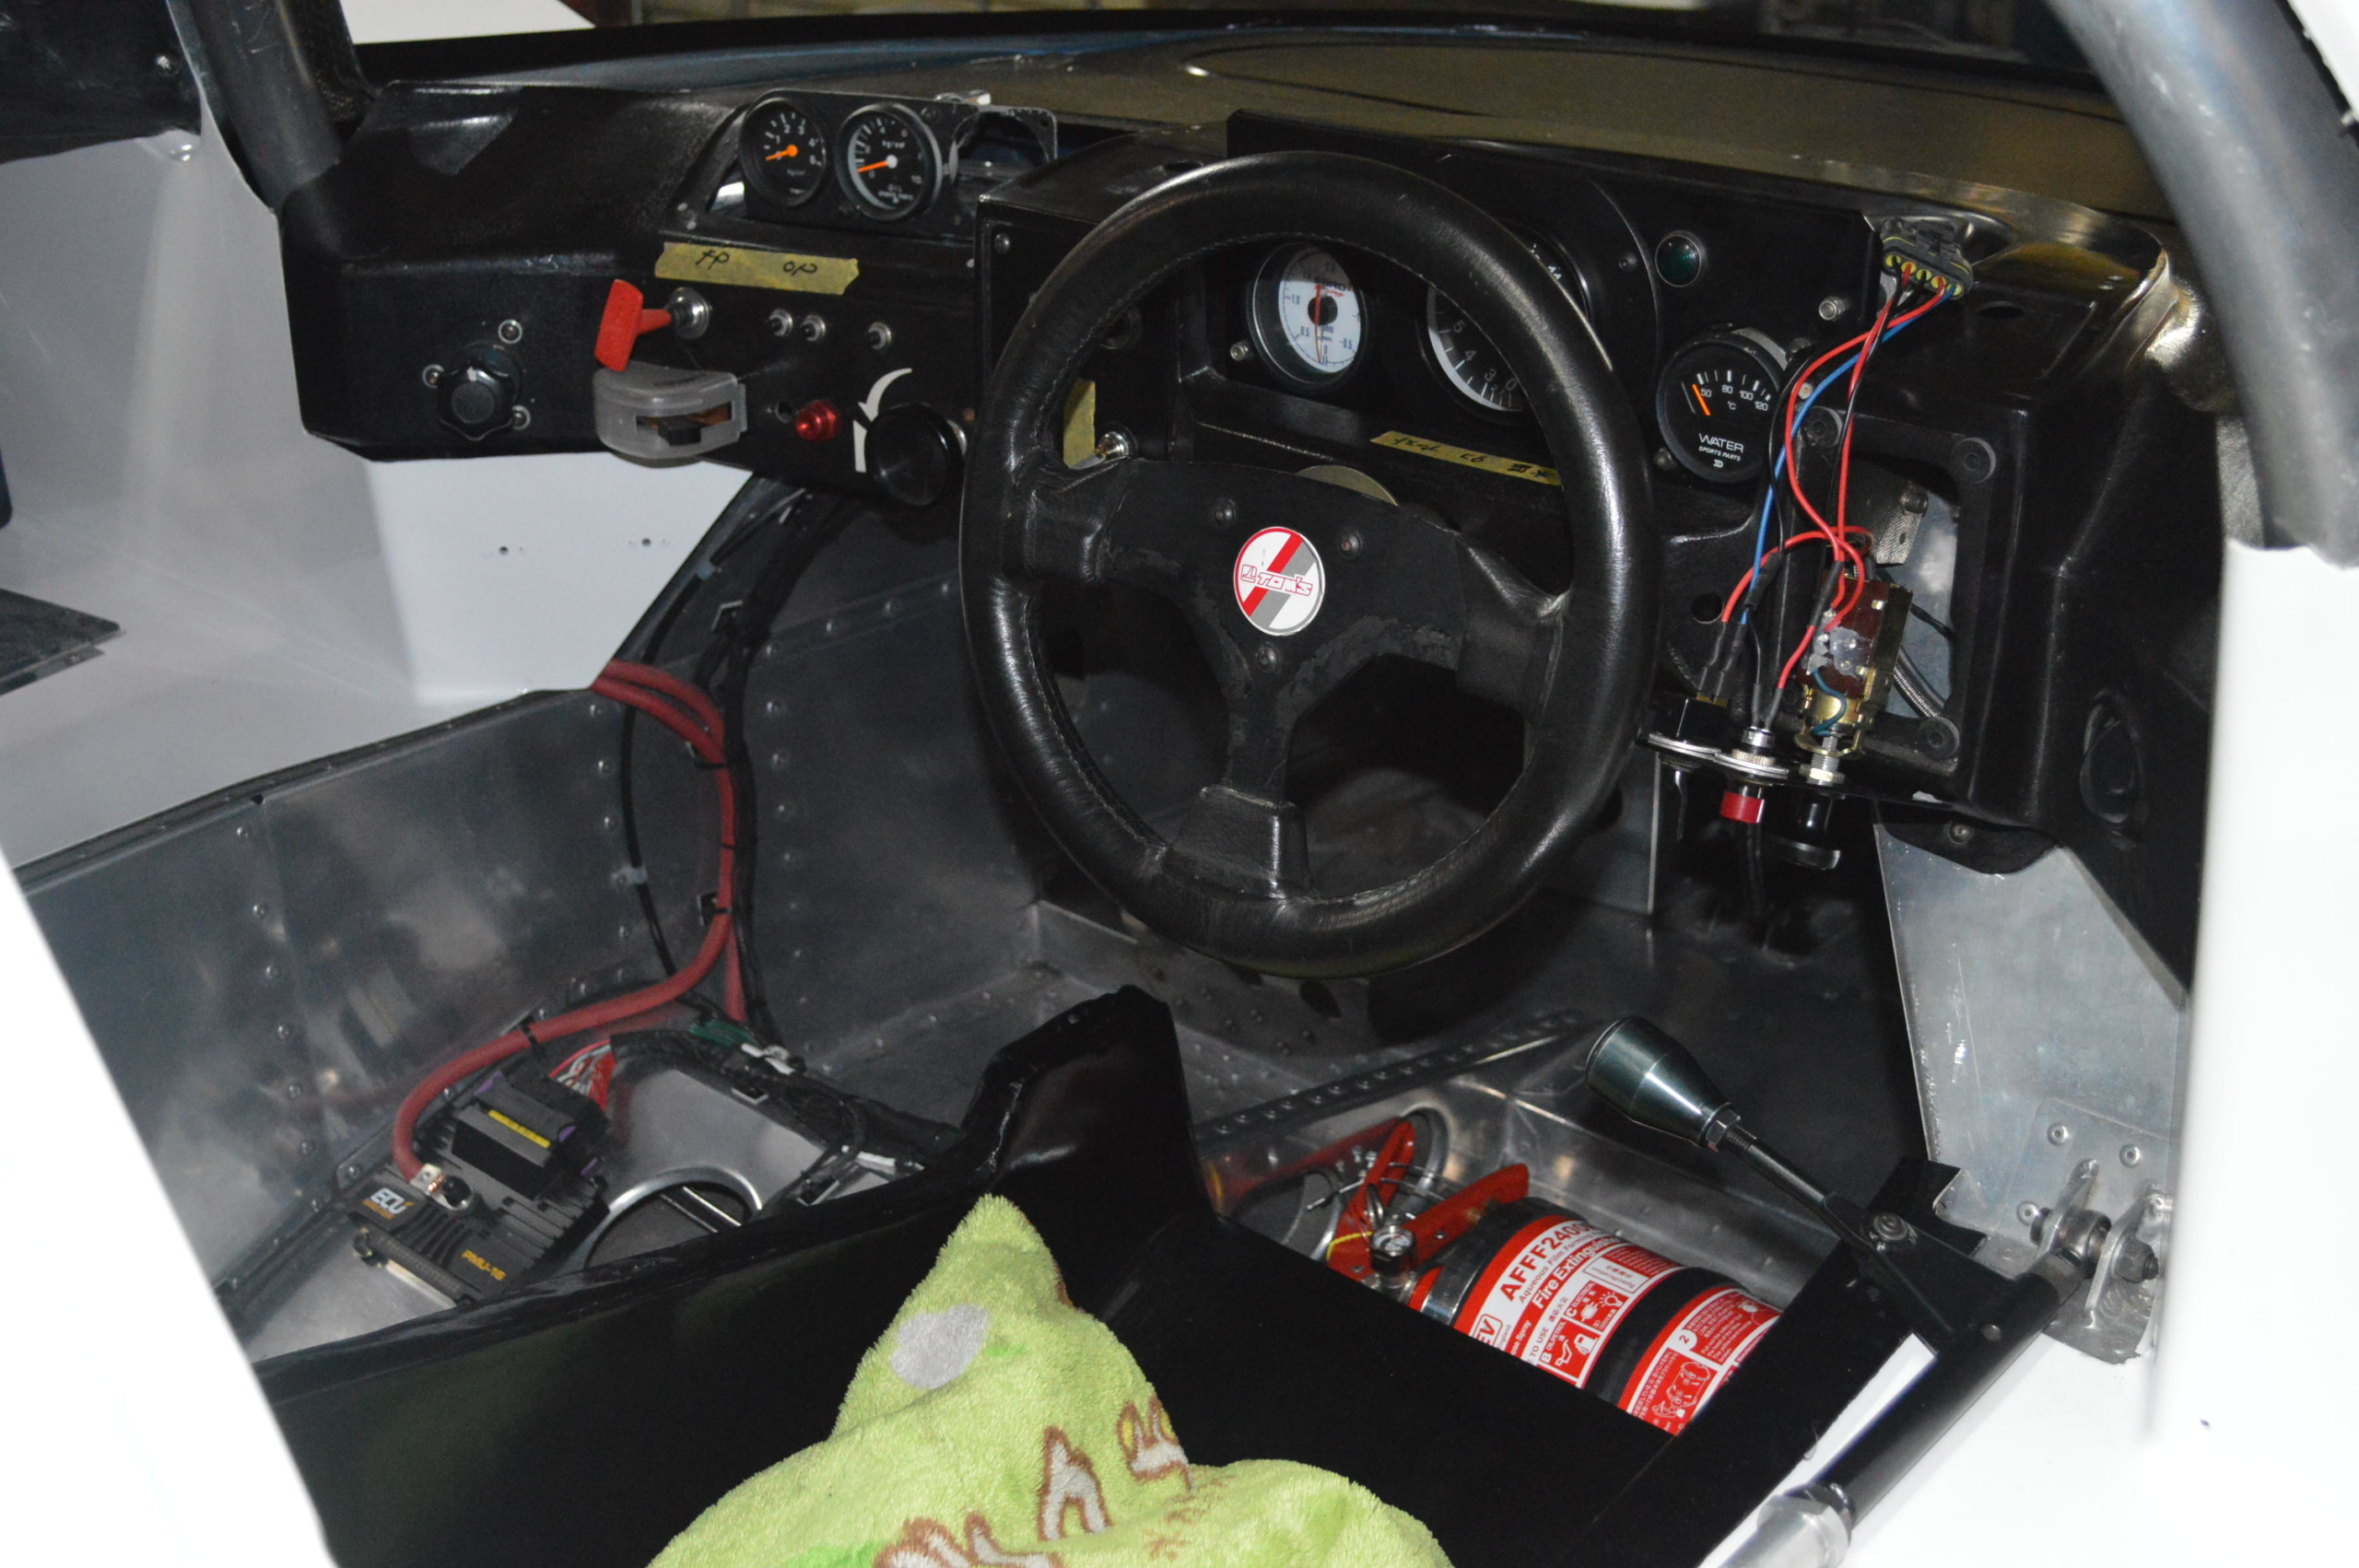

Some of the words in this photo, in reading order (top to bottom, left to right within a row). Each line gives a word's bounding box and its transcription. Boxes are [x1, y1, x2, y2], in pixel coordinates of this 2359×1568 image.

[1701, 388, 1712, 398] 50
[1721, 385, 1733, 394] 80
[1739, 390, 1754, 401] 100
[1754, 401, 1768, 412] 120
[1698, 433, 1744, 453] WATER
[1698, 445, 1721, 457] SPORTS
[1722, 451, 1742, 462] PARTS
[370, 1188, 414, 1214] ECU
[1520, 1266, 1549, 1304] Aqueous
[1547, 1250, 1565, 1266] Film
[1532, 1279, 1559, 1309] Fire
[1567, 1309, 1578, 1317] C
[1516, 1319, 1532, 1340] Spray
[1531, 1345, 1540, 1357] TO
[1537, 1327, 1548, 1344] USE
[1679, 1335, 1690, 1344] 2
[1542, 1353, 1552, 1363] B
